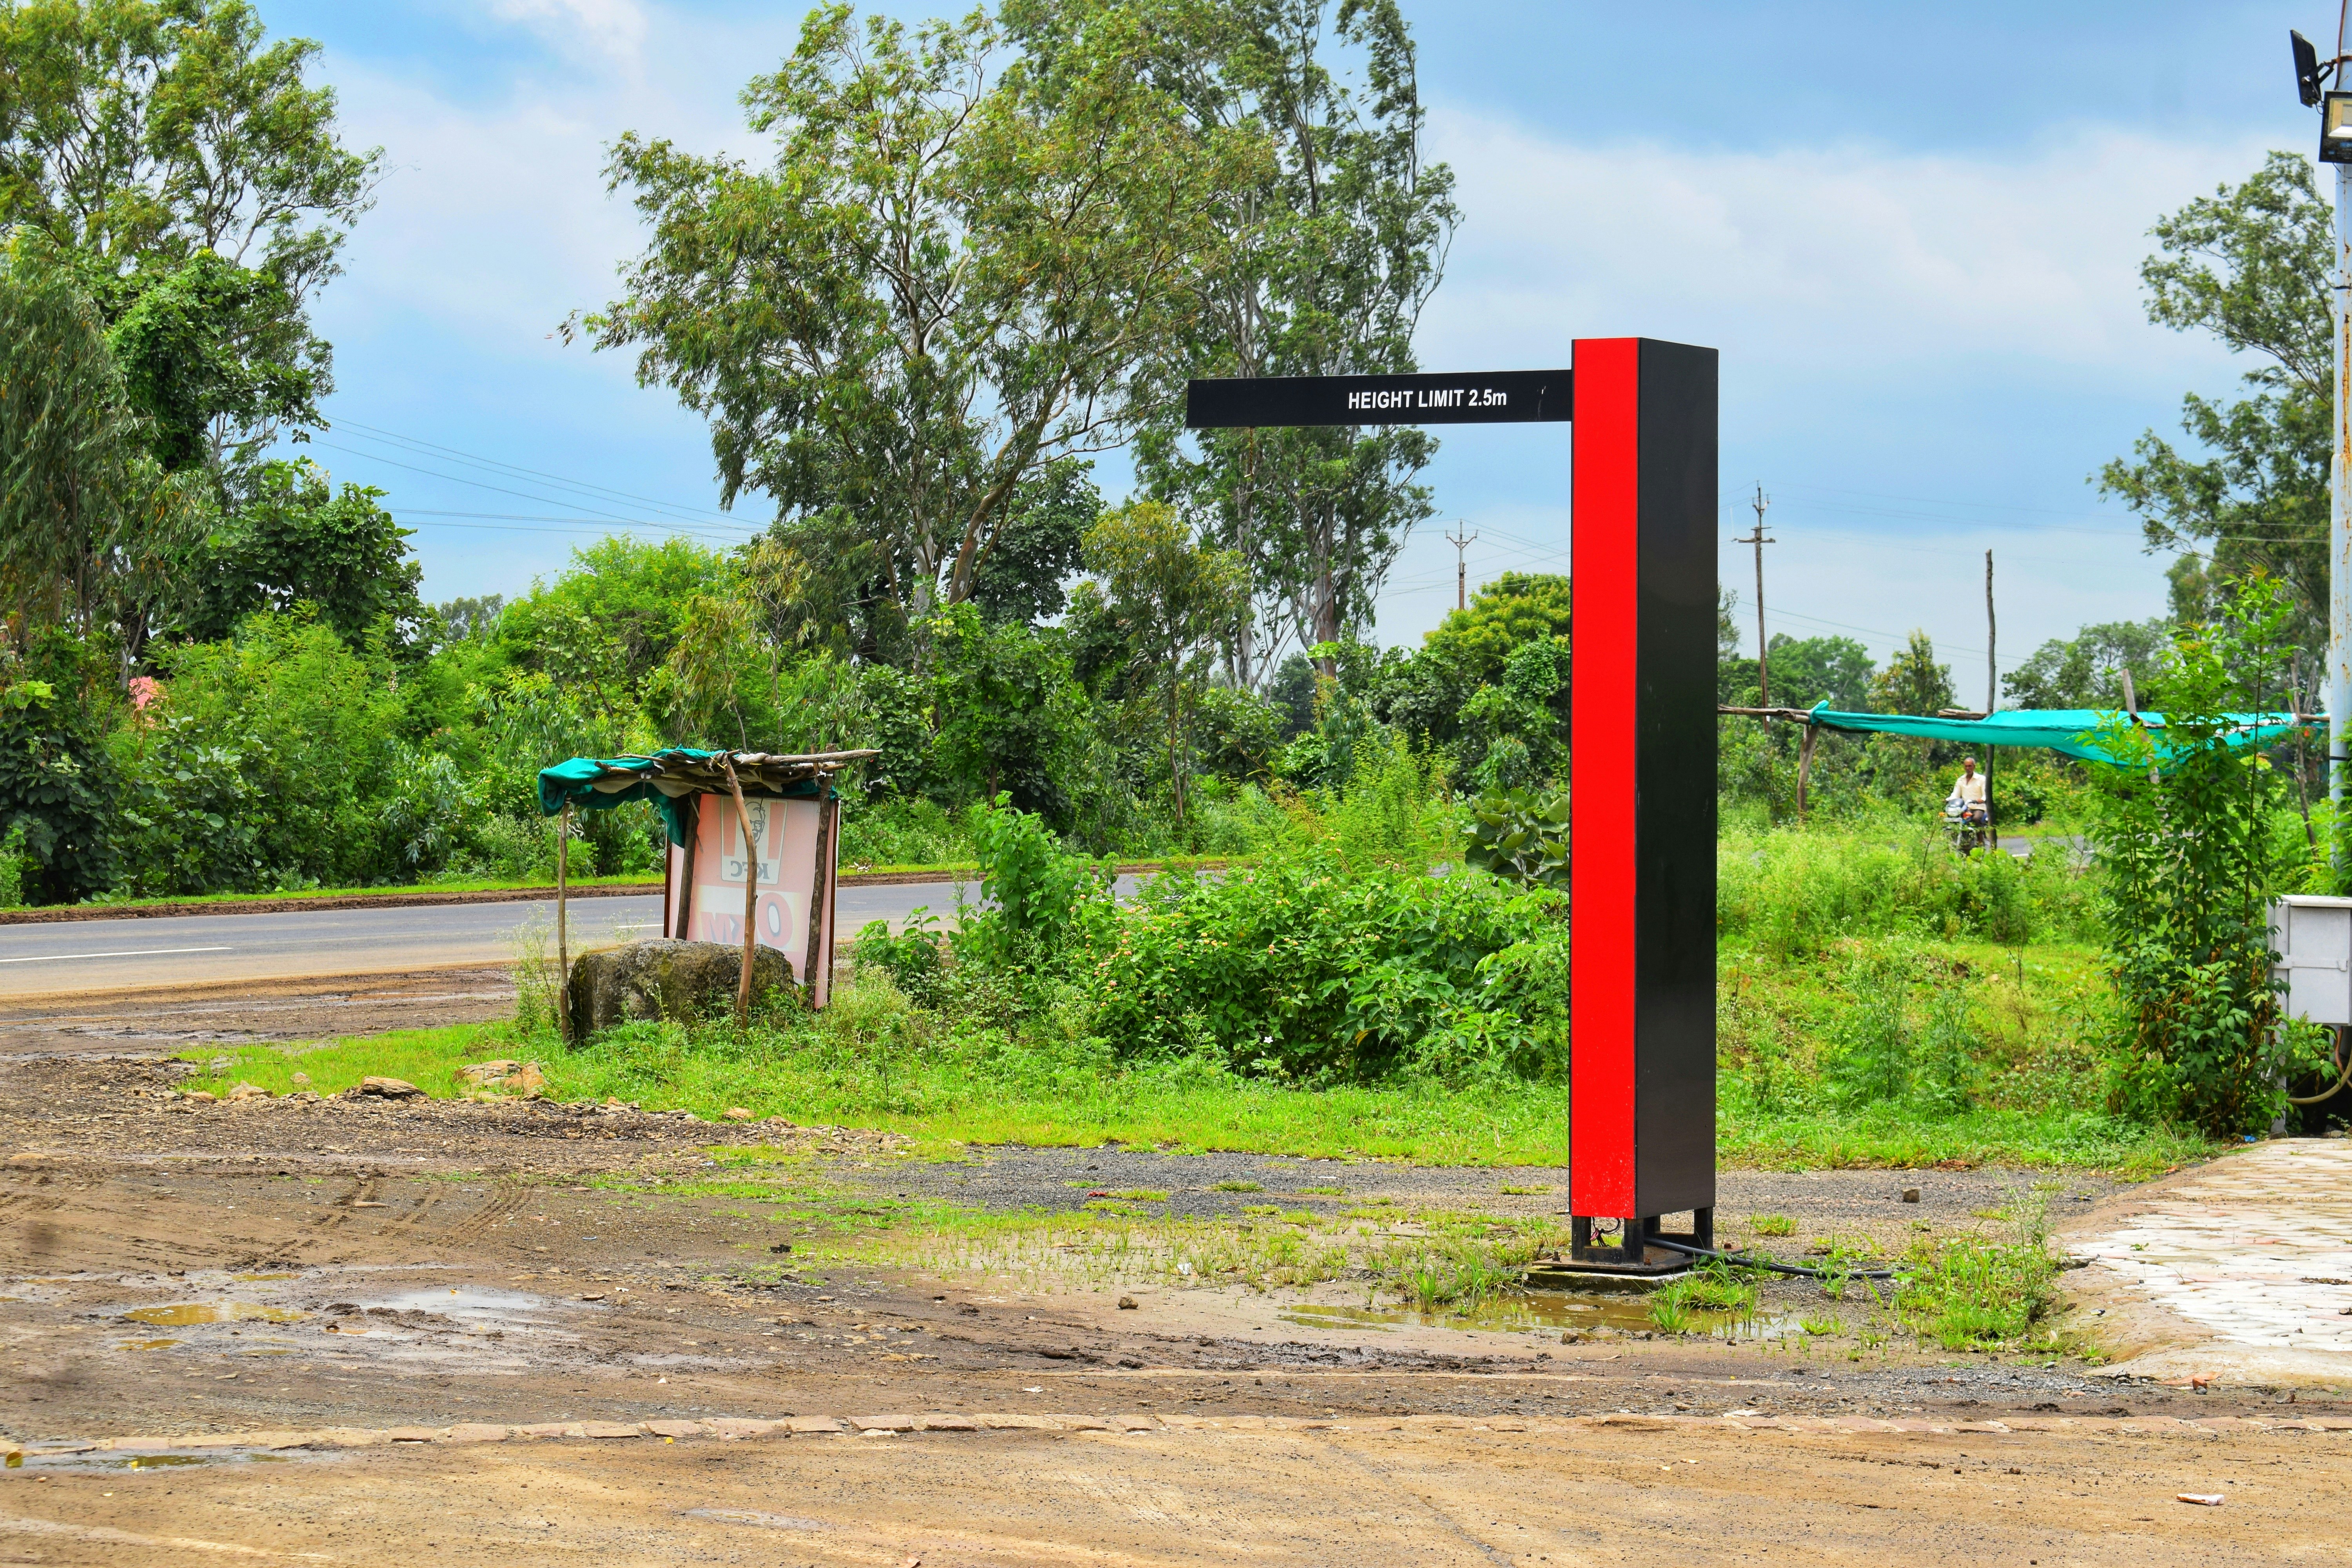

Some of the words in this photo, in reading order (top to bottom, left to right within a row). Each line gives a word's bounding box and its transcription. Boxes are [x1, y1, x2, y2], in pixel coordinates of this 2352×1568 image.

[1348, 390, 1414, 409] HEIGHT
[1418, 390, 1465, 407] LIMIT
[1468, 389, 1507, 407] 2.5m
